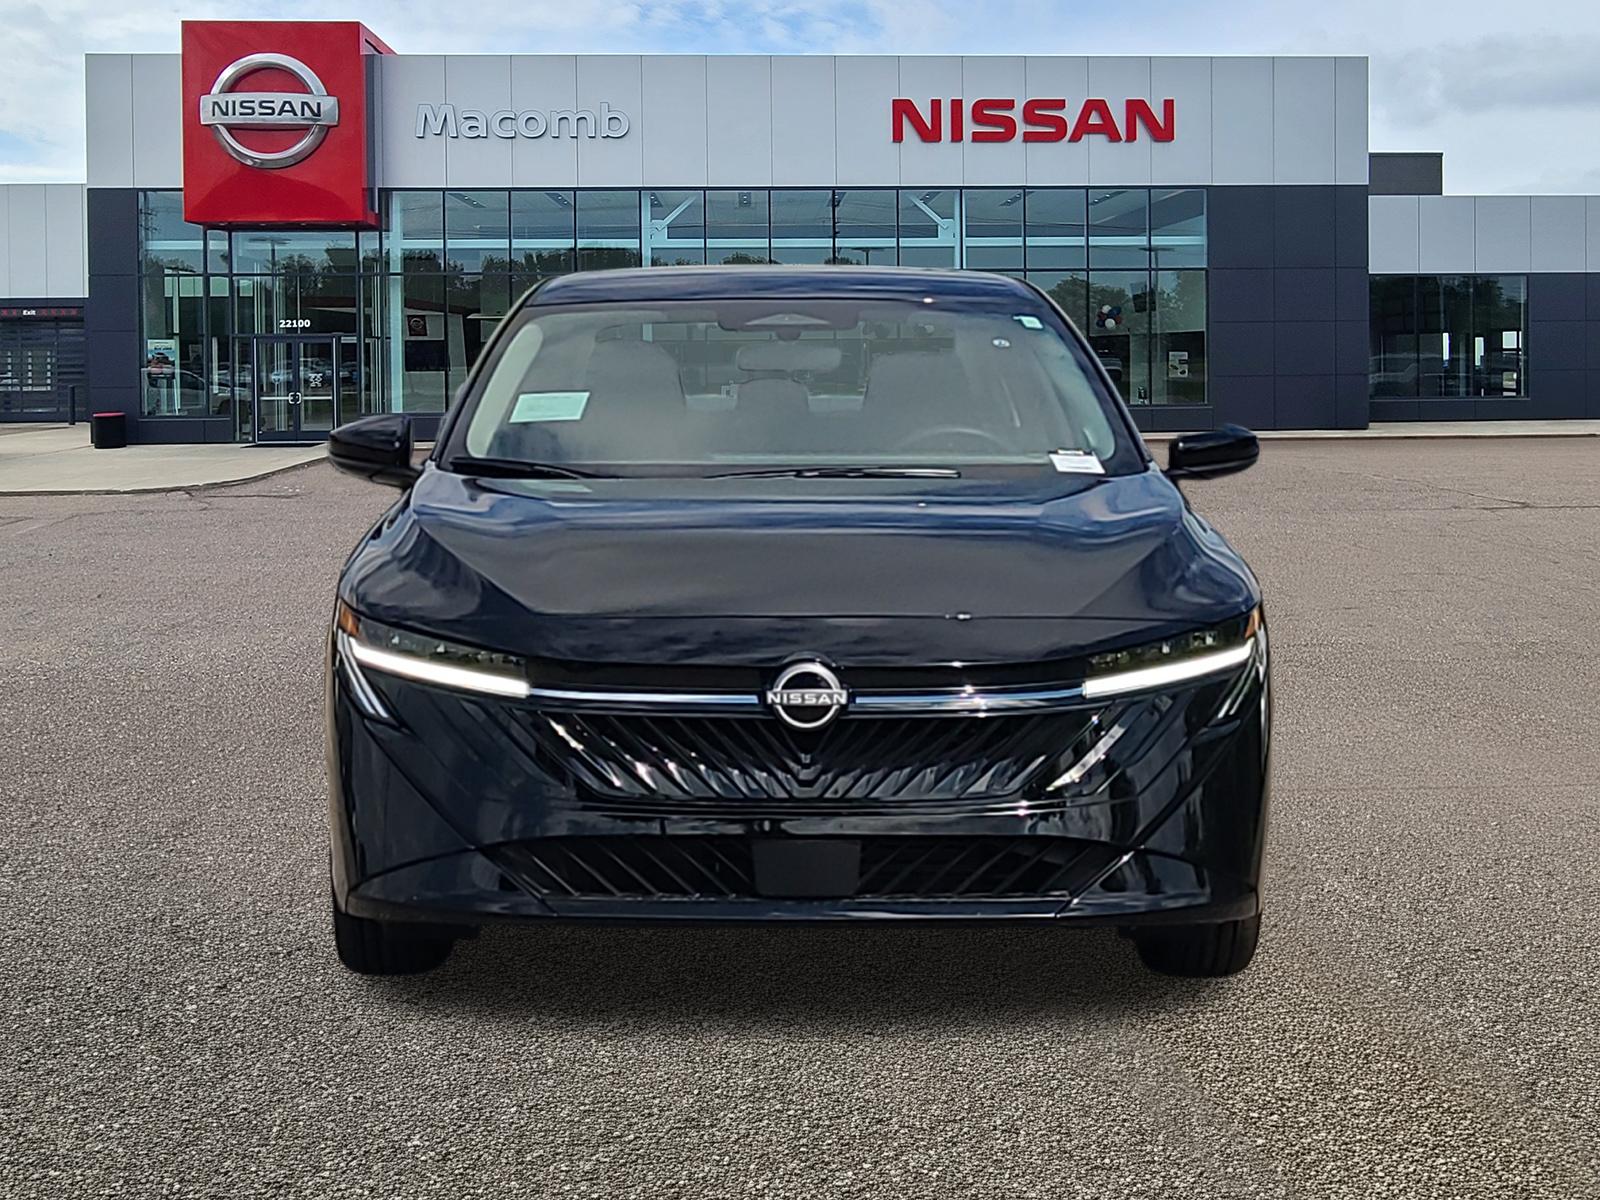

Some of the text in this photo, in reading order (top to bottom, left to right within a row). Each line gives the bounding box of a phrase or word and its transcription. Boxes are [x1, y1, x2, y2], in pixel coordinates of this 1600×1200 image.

[212, 100, 322, 117] NISSAN
[415, 102, 630, 138] Macomb
[892, 98, 1175, 143] NISSAN
[279, 319, 311, 328] 22100
[766, 690, 848, 705] NISSAN
